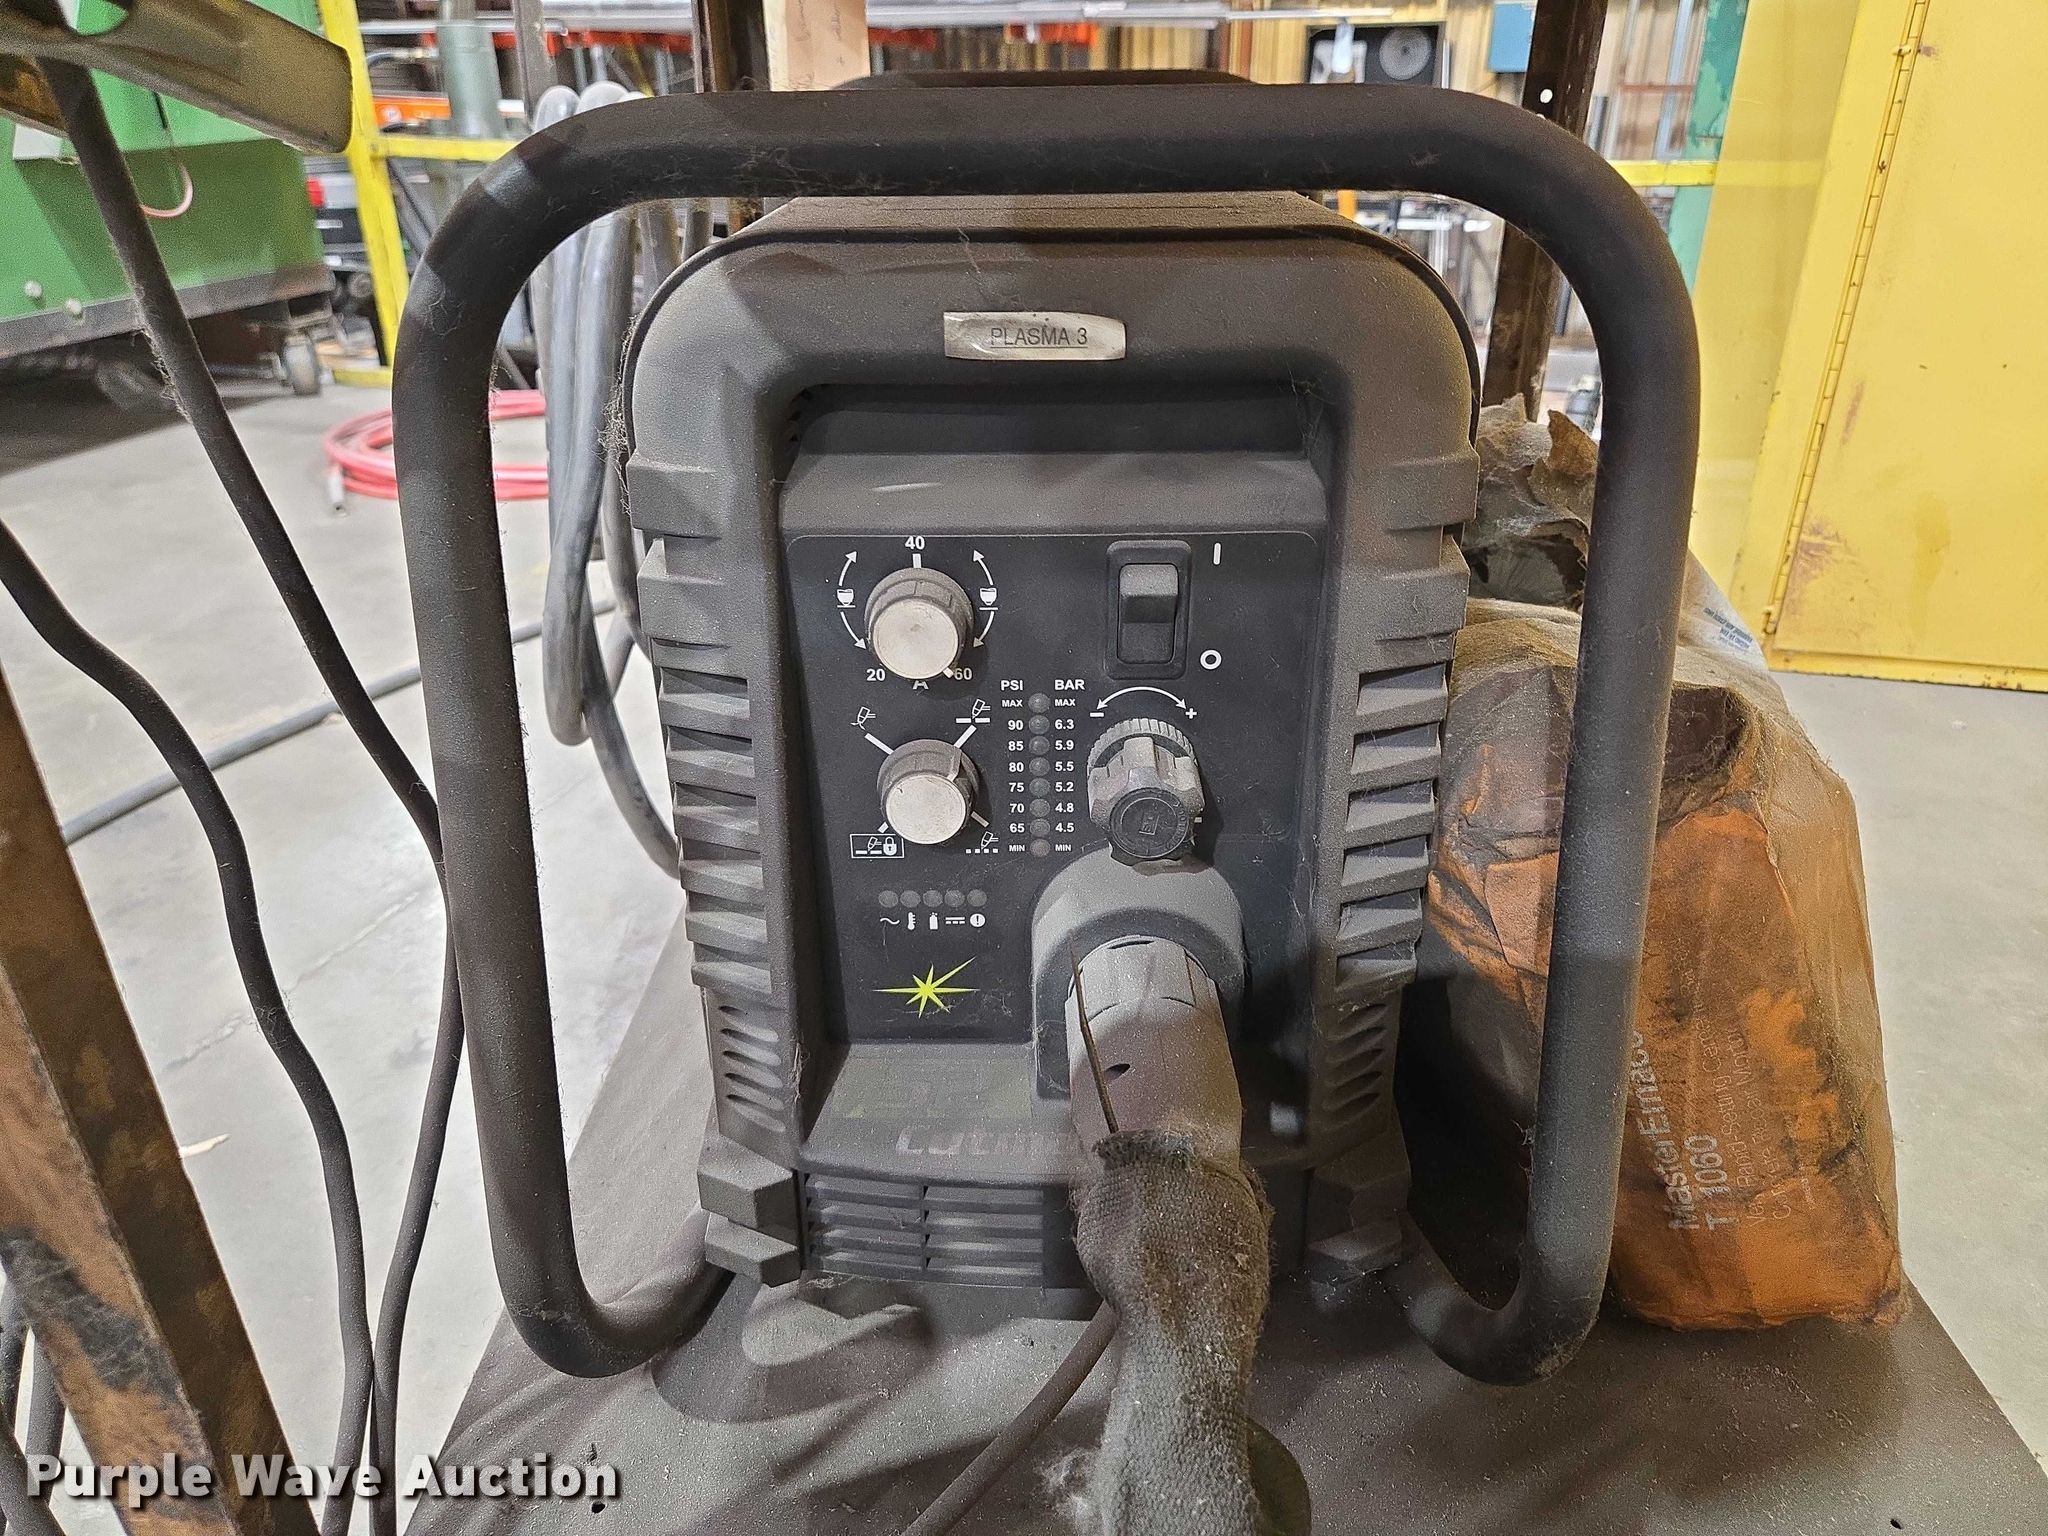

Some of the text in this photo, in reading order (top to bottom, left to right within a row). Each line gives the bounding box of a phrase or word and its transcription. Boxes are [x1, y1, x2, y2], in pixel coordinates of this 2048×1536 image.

[990, 327, 1088, 345] PLASMA 3
[905, 536, 925, 550] 40
[866, 668, 886, 681] 20
[954, 667, 973, 680] 60
[1000, 679, 1023, 691] PSI
[1054, 679, 1085, 691] BAR
[1001, 699, 1023, 708] MAX
[1054, 698, 1076, 707] MAX
[1007, 719, 1024, 731] 90
[1054, 718, 1075, 730] 6.3
[1008, 740, 1024, 752] 85
[1054, 739, 1074, 751] 5.9
[1008, 761, 1024, 773] 80
[1054, 760, 1075, 772] 5.5
[1008, 782, 1025, 793] 75
[1054, 781, 1075, 792] 5.2
[1009, 803, 1025, 814] 70
[1054, 802, 1075, 813] 4.8
[1009, 822, 1025, 833] 65
[1054, 822, 1075, 833] 4.5
[1008, 844, 1026, 852] MIN
[1054, 843, 1072, 852] MIN
[1684, 1135, 1739, 1232] T 1060
